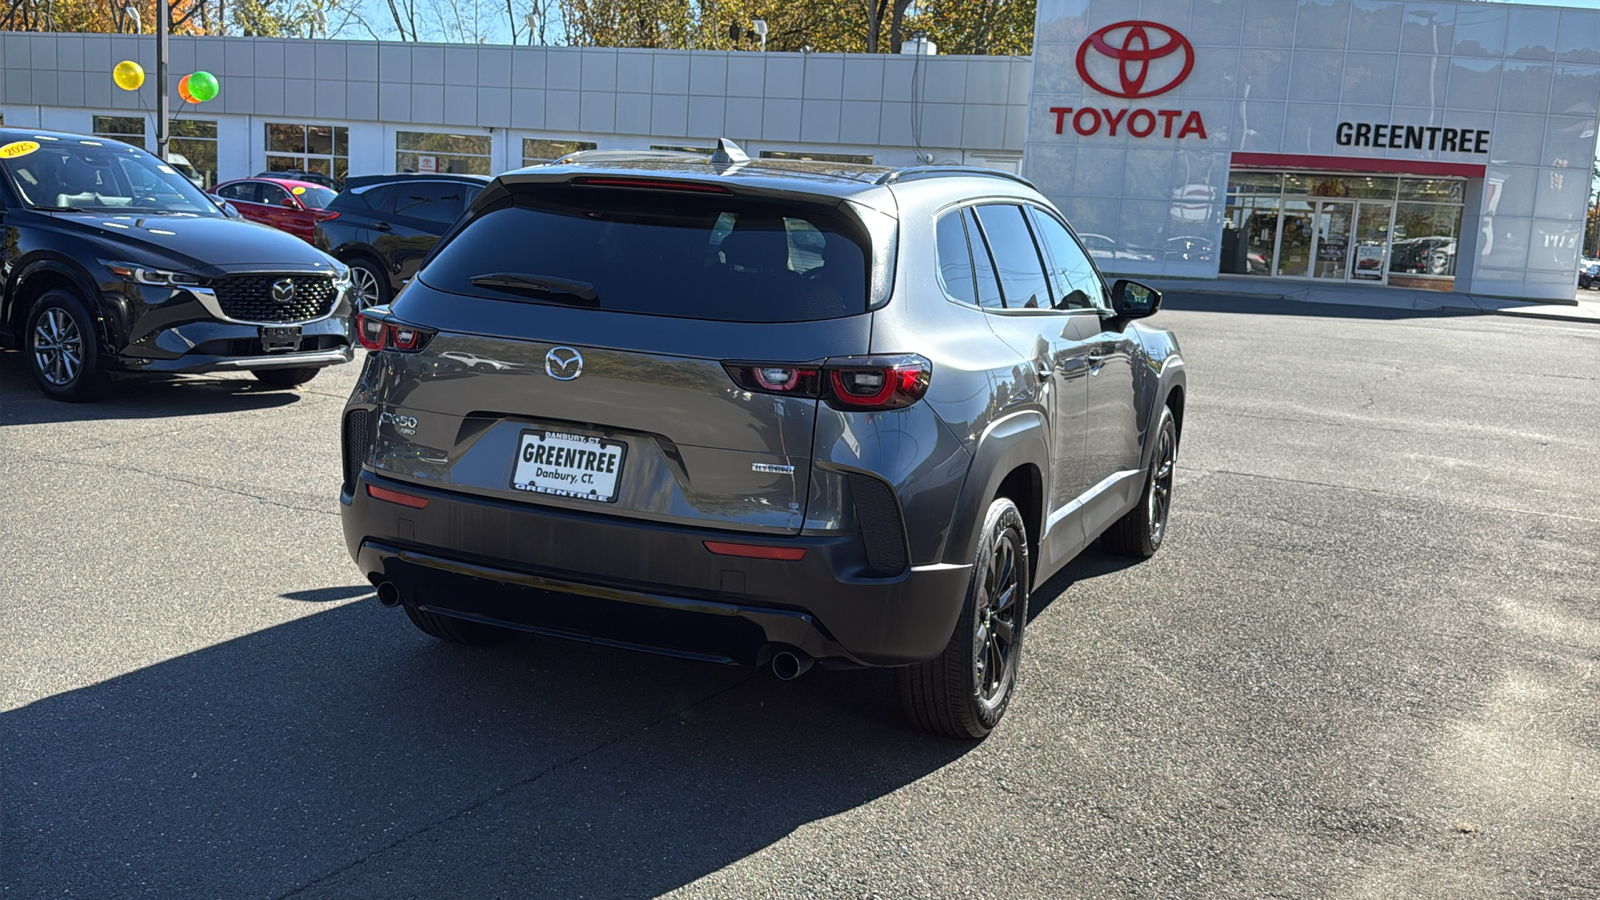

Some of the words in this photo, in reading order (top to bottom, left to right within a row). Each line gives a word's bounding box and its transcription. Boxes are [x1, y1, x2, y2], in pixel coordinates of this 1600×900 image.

[1050, 107, 1207, 139] TOYOTA
[4, 143, 33, 156] 2025
[1336, 122, 1490, 154] GREENTREE
[523, 443, 617, 473] GREENTREE
[536, 467, 578, 484] Danbury,
[581, 473, 594, 484] CT.
[515, 484, 609, 502] GREENTREE
